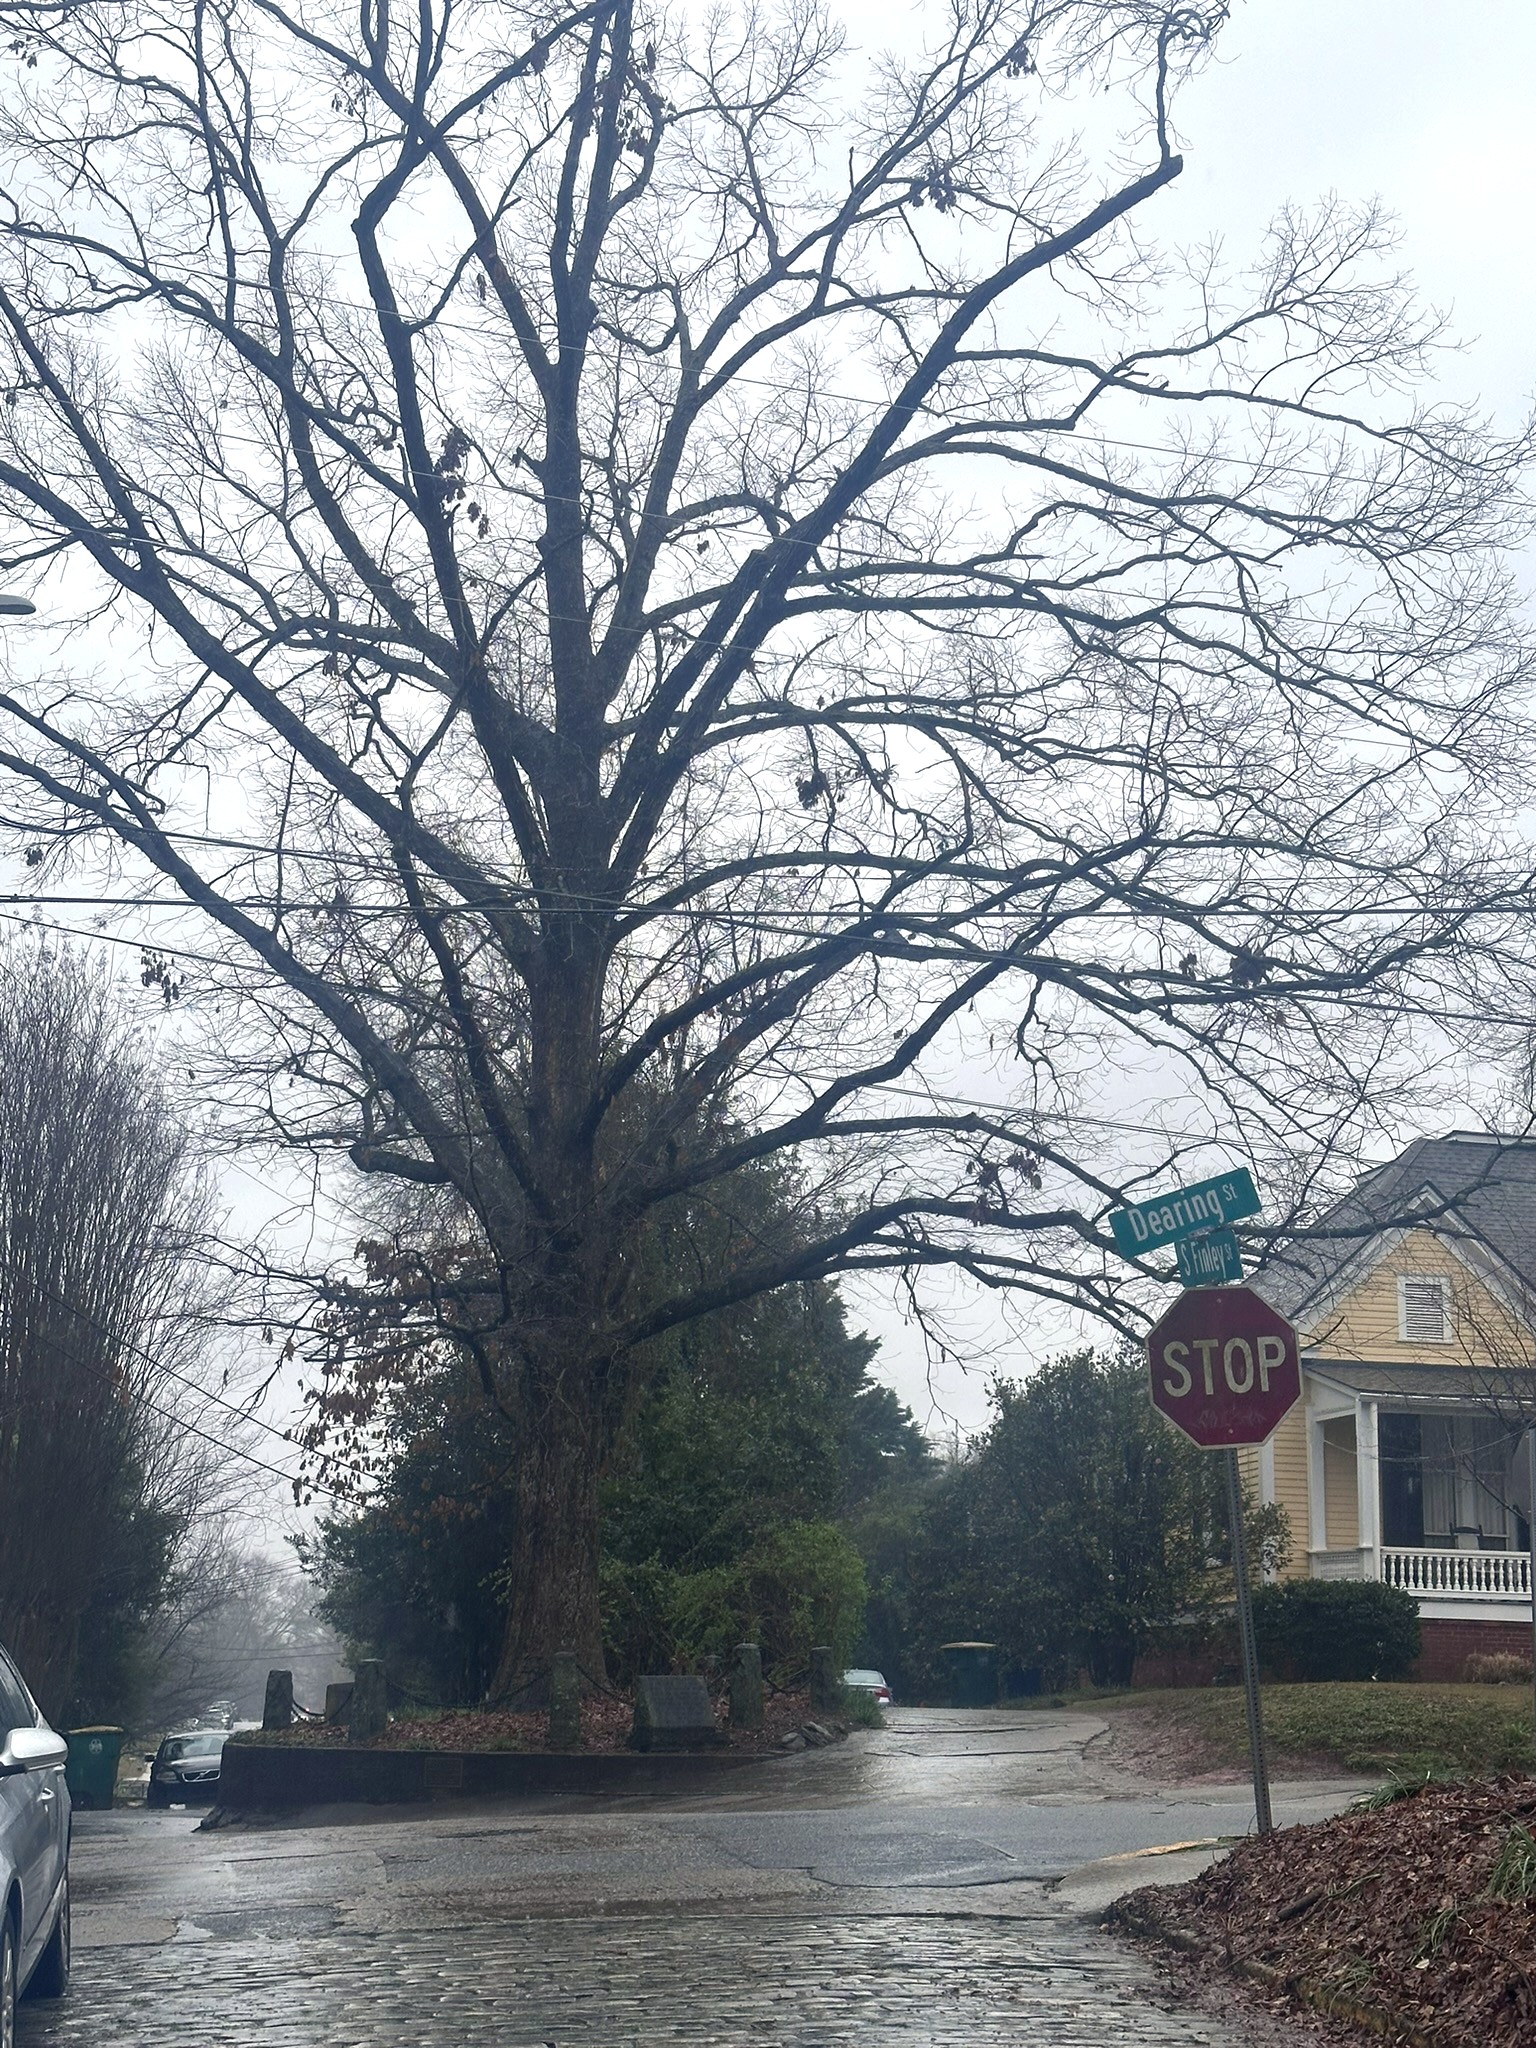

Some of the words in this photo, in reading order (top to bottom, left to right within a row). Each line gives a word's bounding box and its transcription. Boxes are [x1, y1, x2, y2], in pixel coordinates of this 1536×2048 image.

[1127, 1189, 1225, 1242] Dearing
[1222, 1183, 1238, 1202] St
[1180, 1242, 1191, 1277] S
[1190, 1240, 1227, 1279] Finley
[1224, 1243, 1234, 1261] St
[1162, 1335, 1287, 1398] STOP
